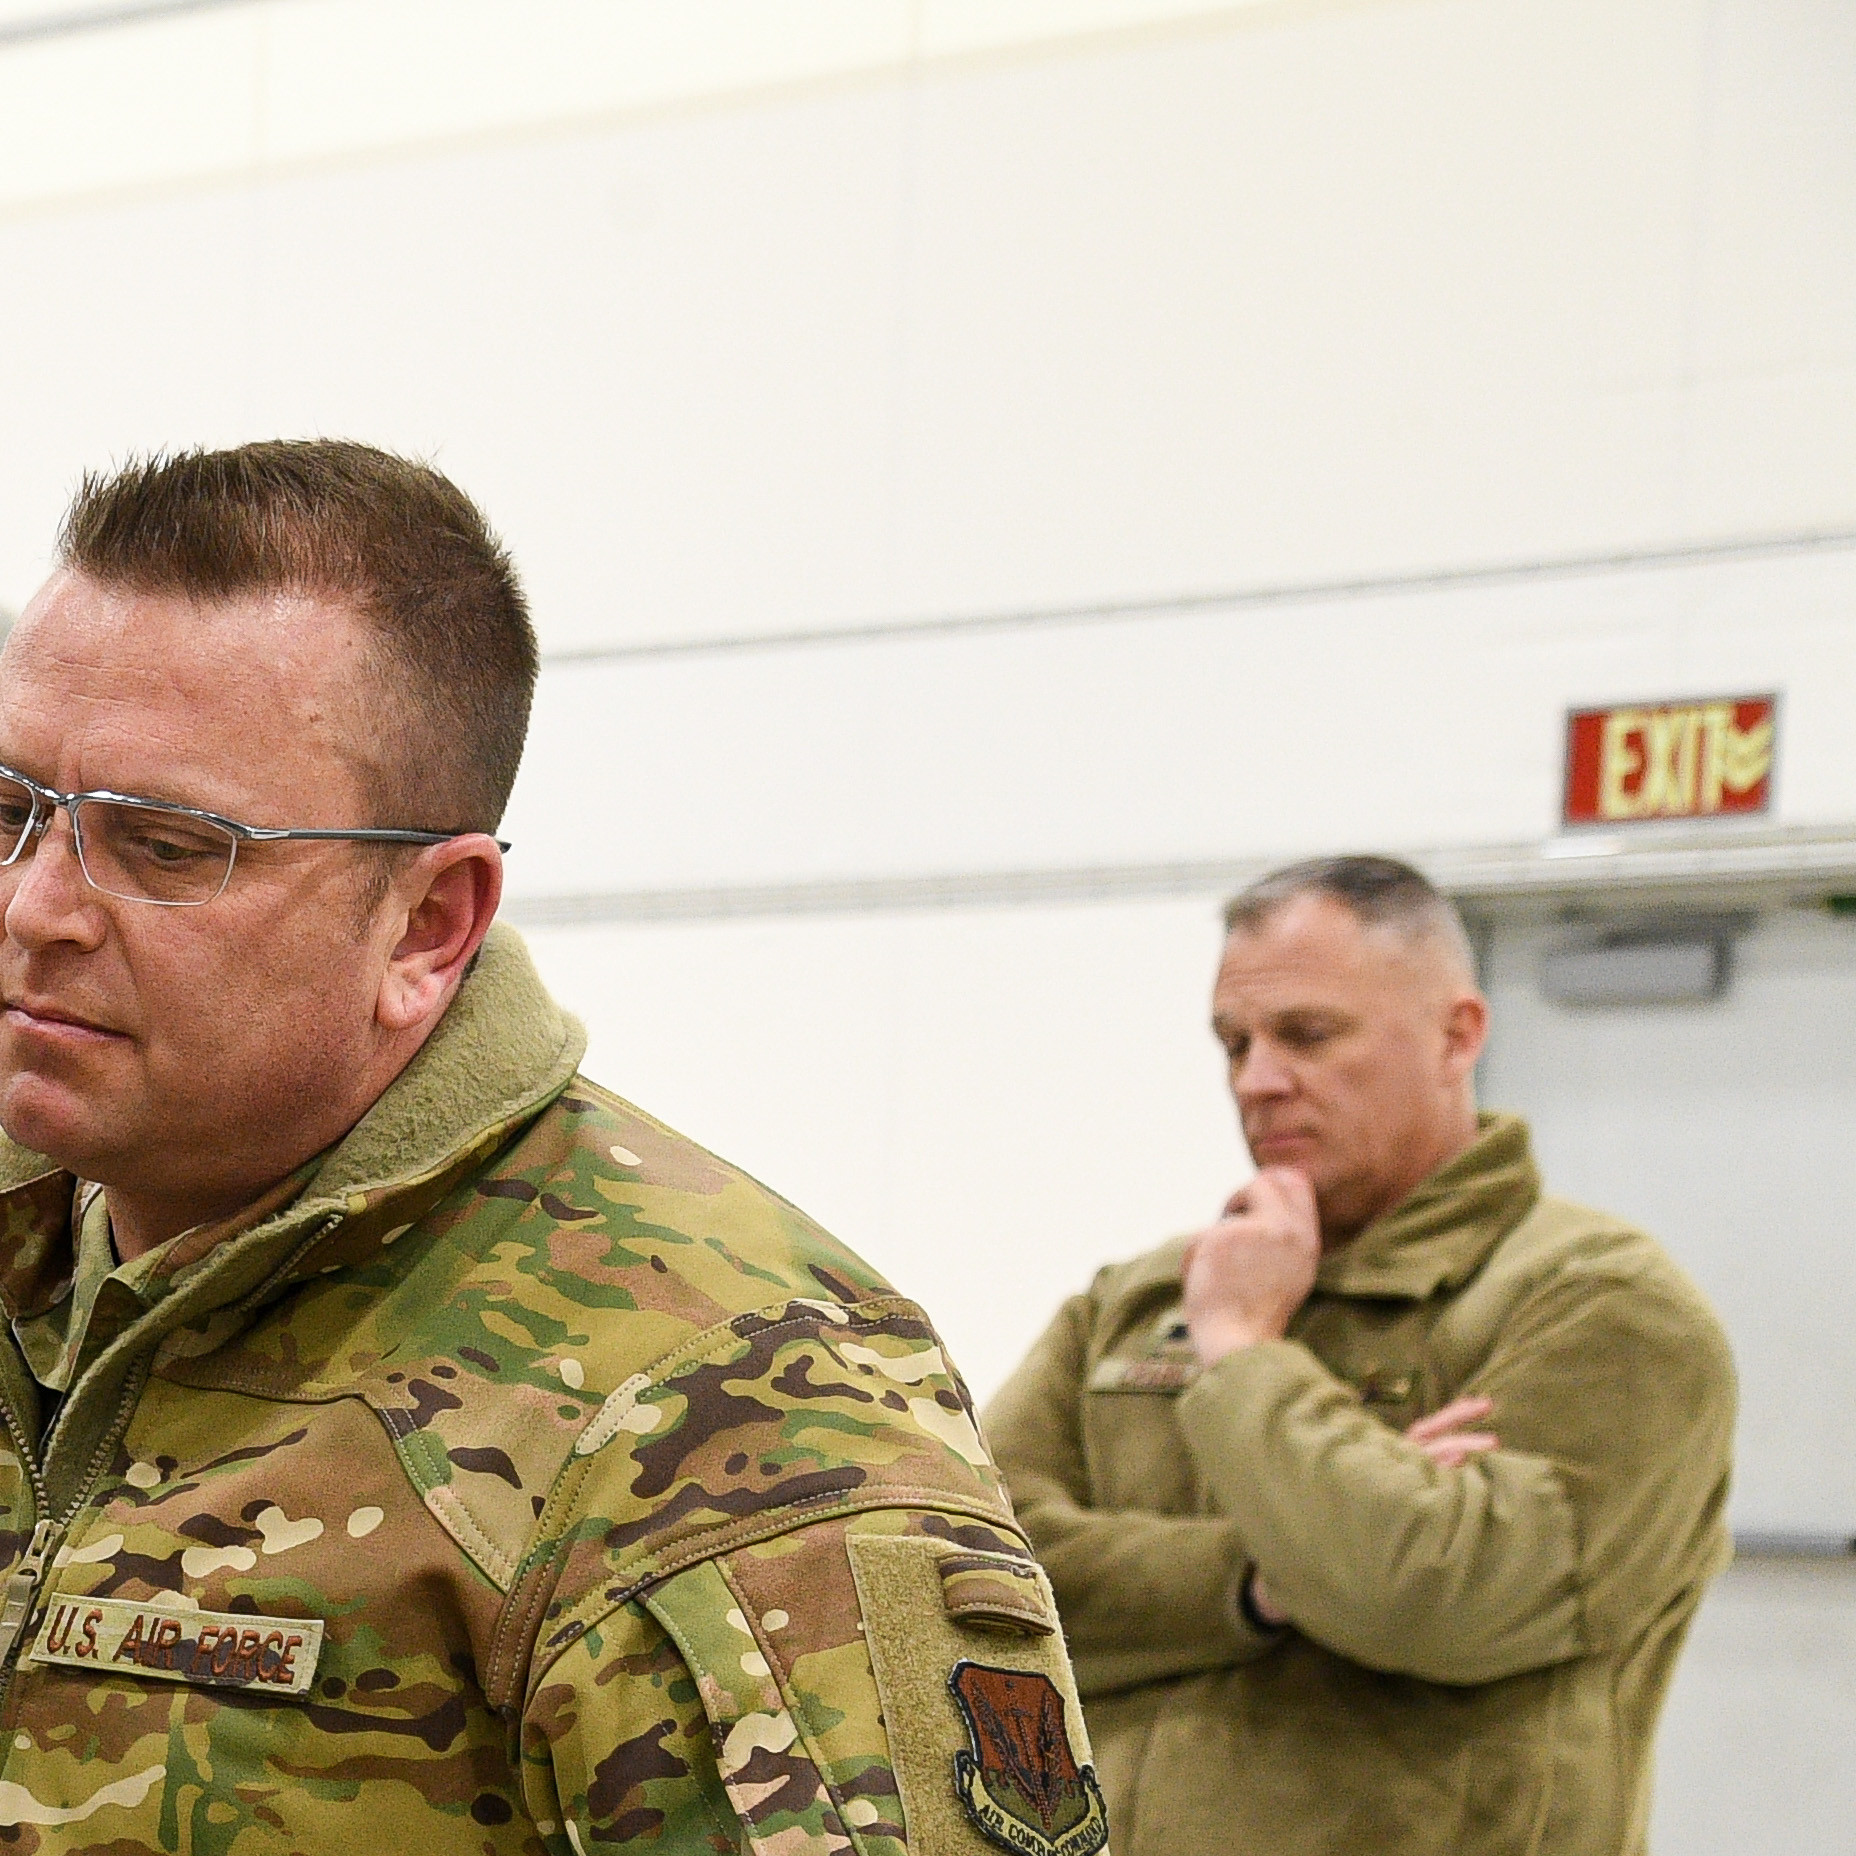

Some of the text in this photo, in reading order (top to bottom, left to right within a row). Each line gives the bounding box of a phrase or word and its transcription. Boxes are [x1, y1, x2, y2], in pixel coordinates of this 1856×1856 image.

[1601, 703, 1730, 821] EXIT
[46, 1604, 303, 1686] U.S. AIR FORCE
[978, 1804, 1005, 1833] AIR
